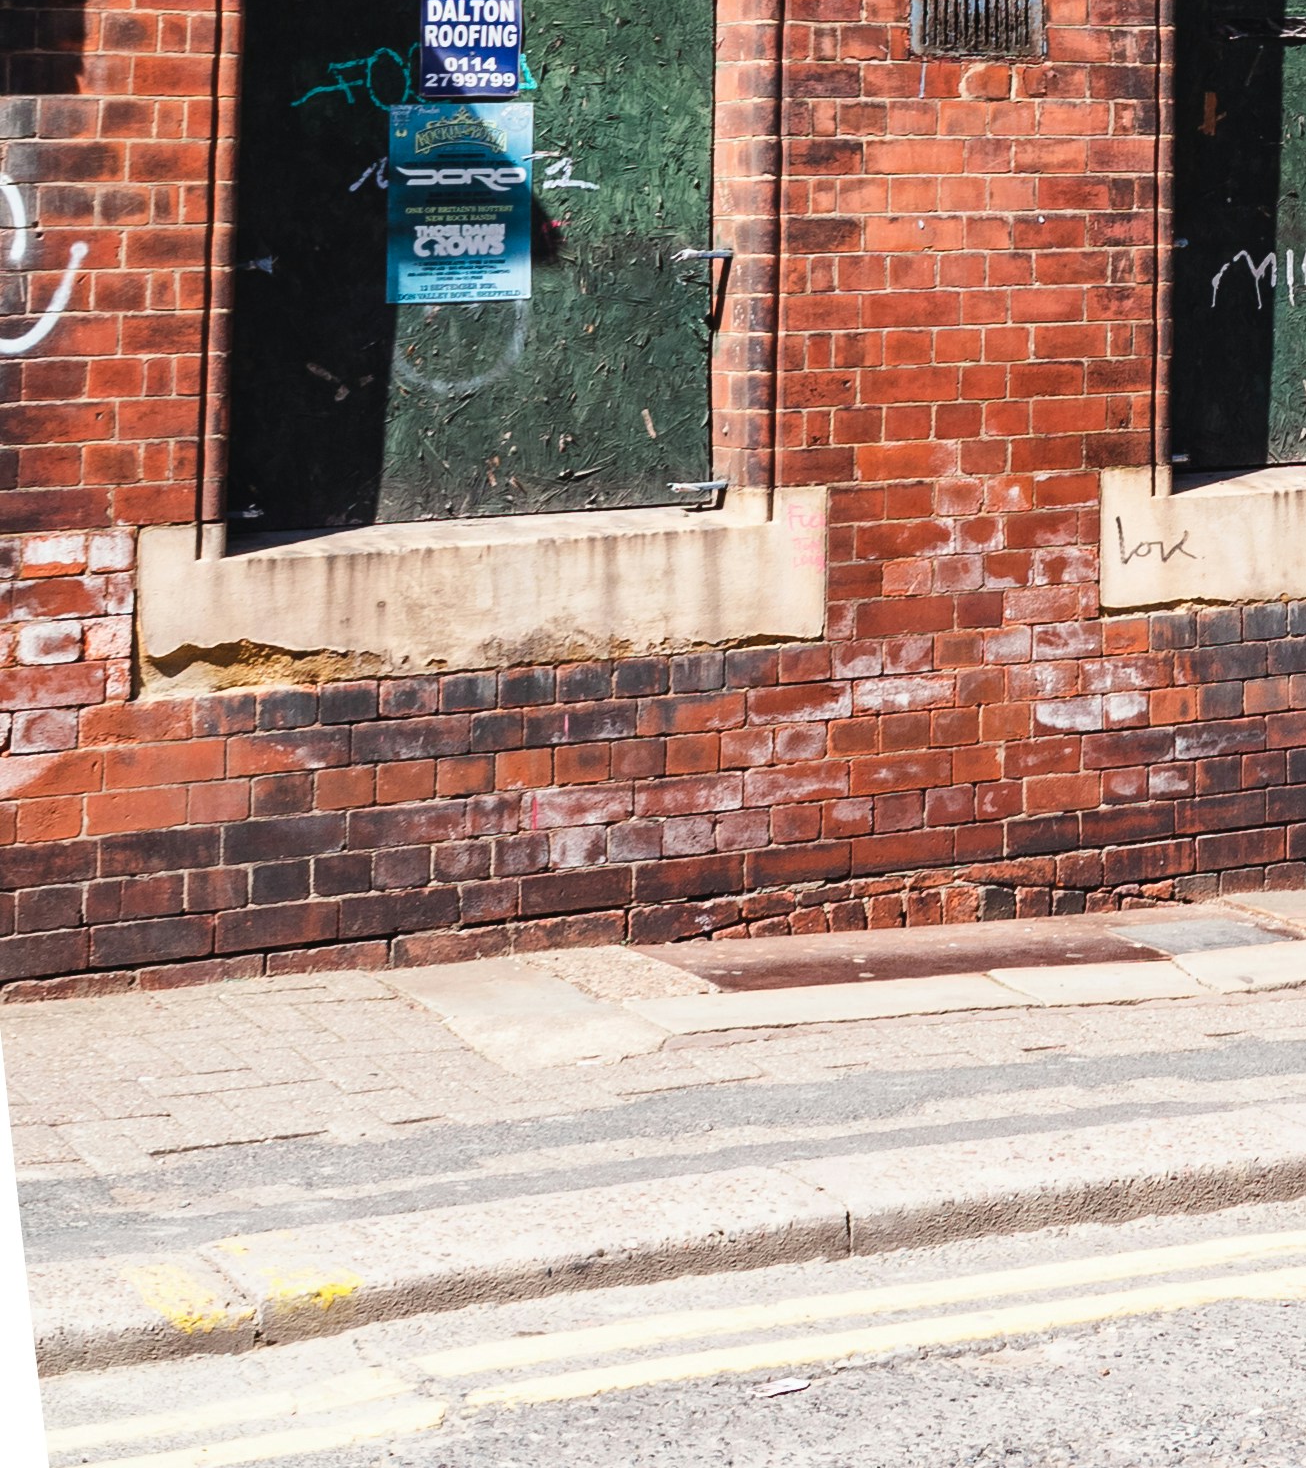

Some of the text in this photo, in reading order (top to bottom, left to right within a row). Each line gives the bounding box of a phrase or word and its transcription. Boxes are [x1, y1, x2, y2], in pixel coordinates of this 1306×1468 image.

[427, 0, 515, 22] DALTON
[424, 24, 518, 48] ROOFING
[444, 56, 498, 72] 0114
[424, 72, 516, 88] 2799799
[413, 236, 505, 257] CROWS
